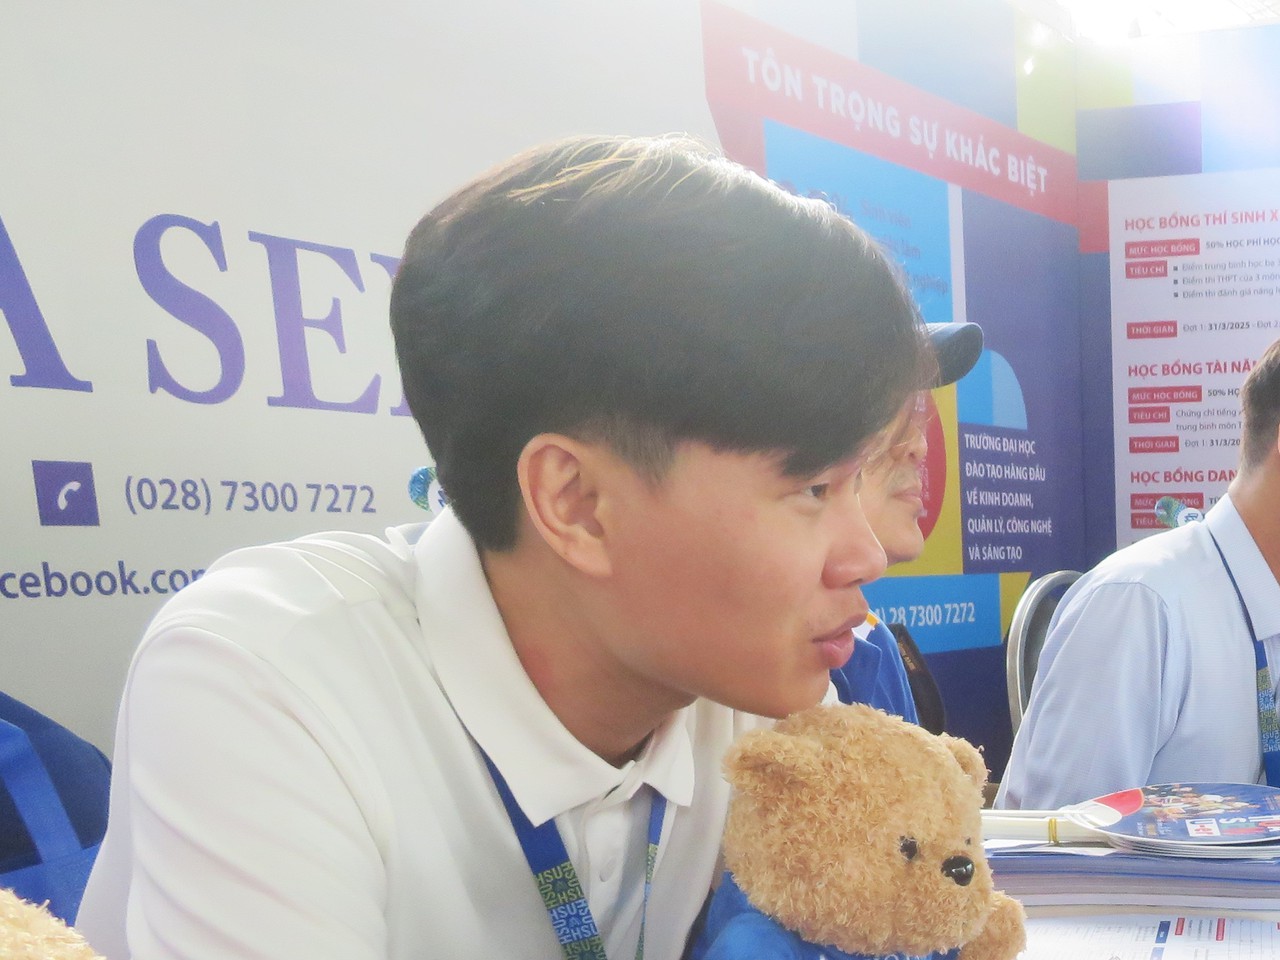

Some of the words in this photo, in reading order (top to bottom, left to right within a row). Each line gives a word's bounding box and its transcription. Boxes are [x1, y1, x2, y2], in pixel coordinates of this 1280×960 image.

[741, 46, 801, 101] TÔN
[812, 74, 900, 138] TRỌNG
[909, 114, 938, 159] SỰ
[945, 132, 1001, 177] KHÁC
[1008, 153, 1048, 197] BIỆT
[1125, 217, 1154, 233] HỌC
[1159, 212, 1200, 230] BỔNG
[1204, 209, 1227, 225] THÍ
[1232, 209, 1266, 224] SINH
[1226, 238, 1245, 249] HỌC
[1247, 236, 1262, 247] PHÍ
[133, 213, 412, 417] SE
[1208, 321, 1250, 332] 31/3/2025
[1128, 363, 1157, 380] HỌC
[1161, 359, 1203, 376] BỔNG
[1206, 359, 1227, 375] TÀI
[965, 432, 1001, 453] TRƯỜNG
[1002, 436, 1017, 456] ĐẠI
[1018, 440, 1036, 458] HỌC
[966, 462, 984, 478] ĐÀO
[986, 463, 1002, 482] TẠO
[1003, 463, 1028, 481] HÀNG
[1029, 465, 1046, 482] ĐẦU
[1130, 470, 1160, 487] HỌC
[1163, 467, 1204, 484] BỔNG
[124, 475, 211, 516] (028)
[220, 480, 299, 514] 7300
[305, 483, 377, 514] 7272
[967, 489, 978, 505] VỀ
[980, 491, 1000, 506] KINH
[1002, 492, 1034, 509] DOANH,
[968, 517, 992, 535] QUẢN
[994, 518, 1005, 536] LÝ,
[1006, 517, 1030, 533] CÔNG
[1031, 518, 1053, 537] NGHỆ
[968, 546, 981, 561] VÀ
[982, 544, 1005, 560] SÁNG
[1007, 545, 1022, 563] TẠO
[910, 604, 942, 627] 7300
[945, 602, 976, 624] 7272
[550, 901, 576, 921] HSU
